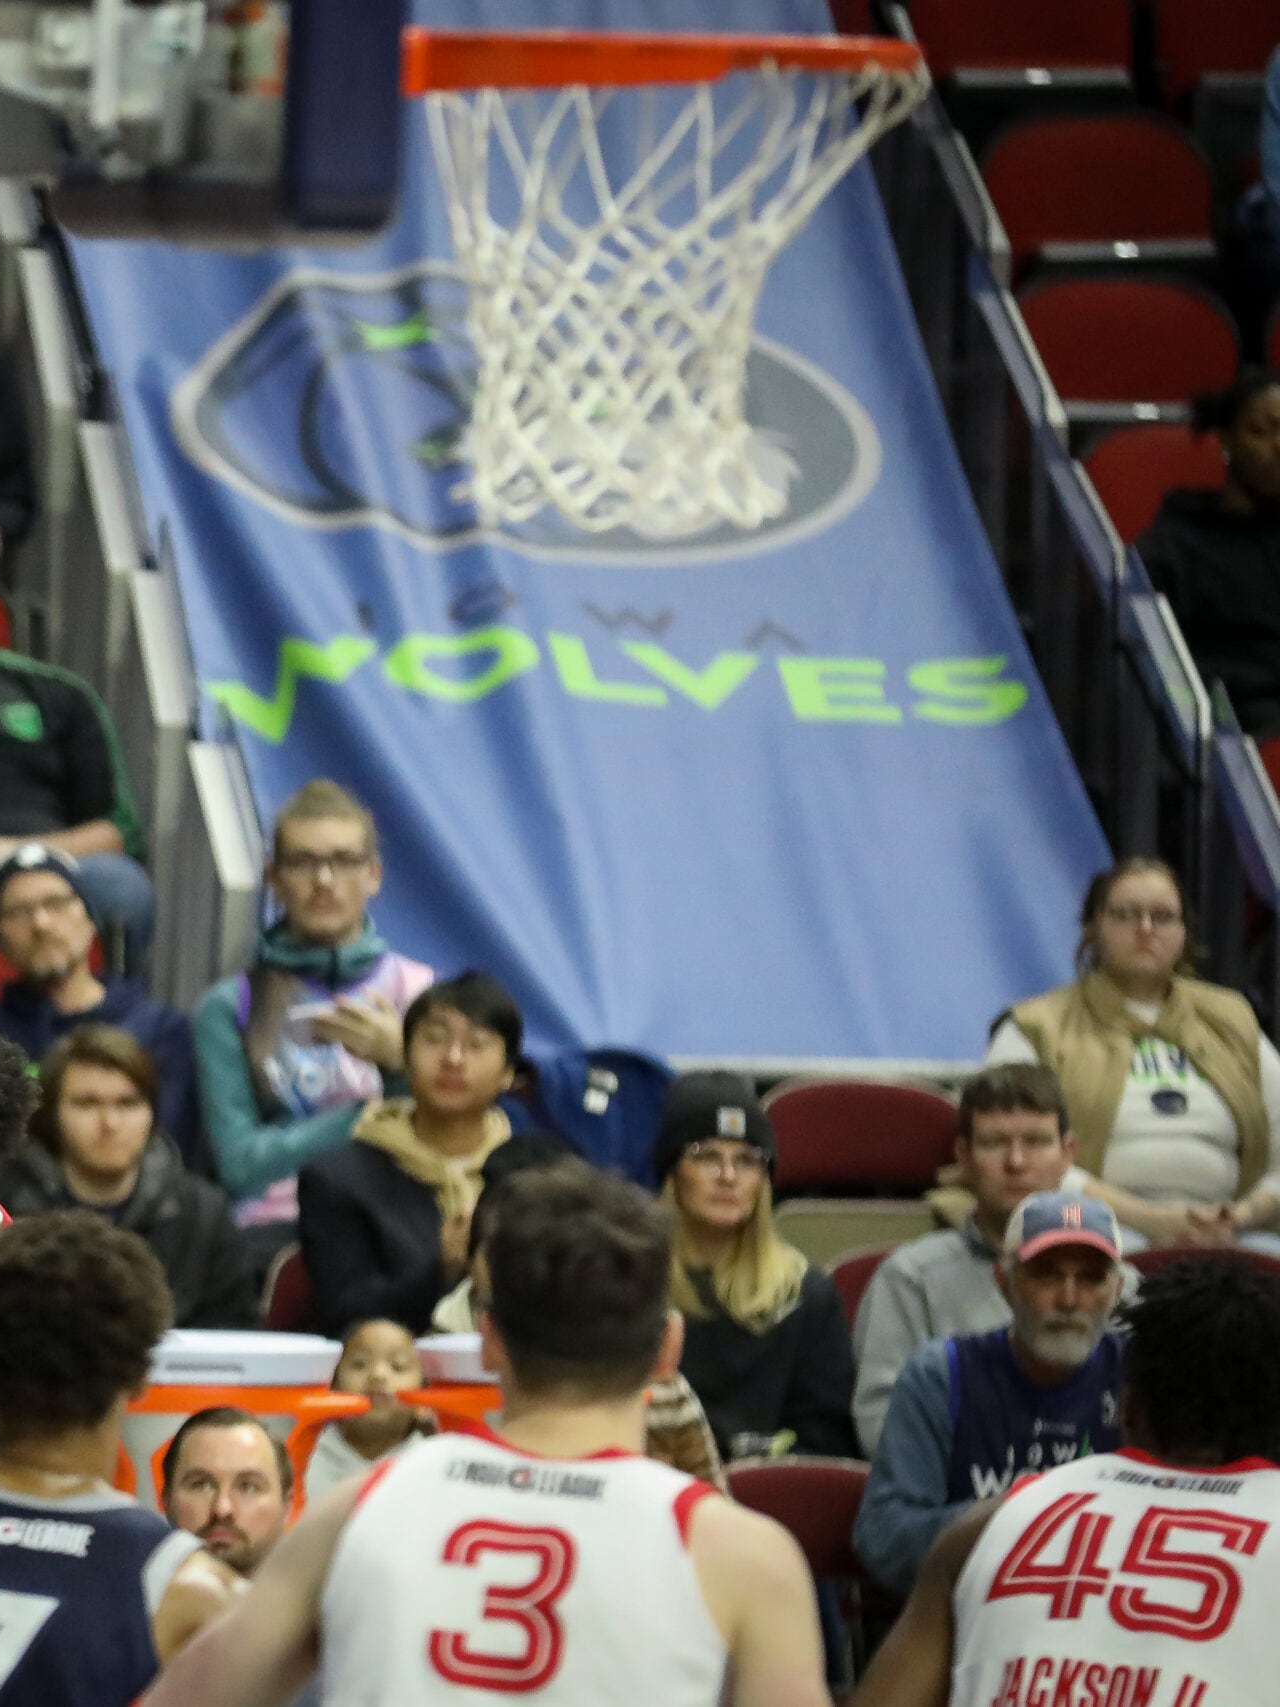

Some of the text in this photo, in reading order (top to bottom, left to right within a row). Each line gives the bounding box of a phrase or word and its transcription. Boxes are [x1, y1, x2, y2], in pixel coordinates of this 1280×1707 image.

[204, 625, 1028, 743] WOLVES
[428, 1519, 578, 1695] 3
[987, 1492, 1270, 1642] 45
